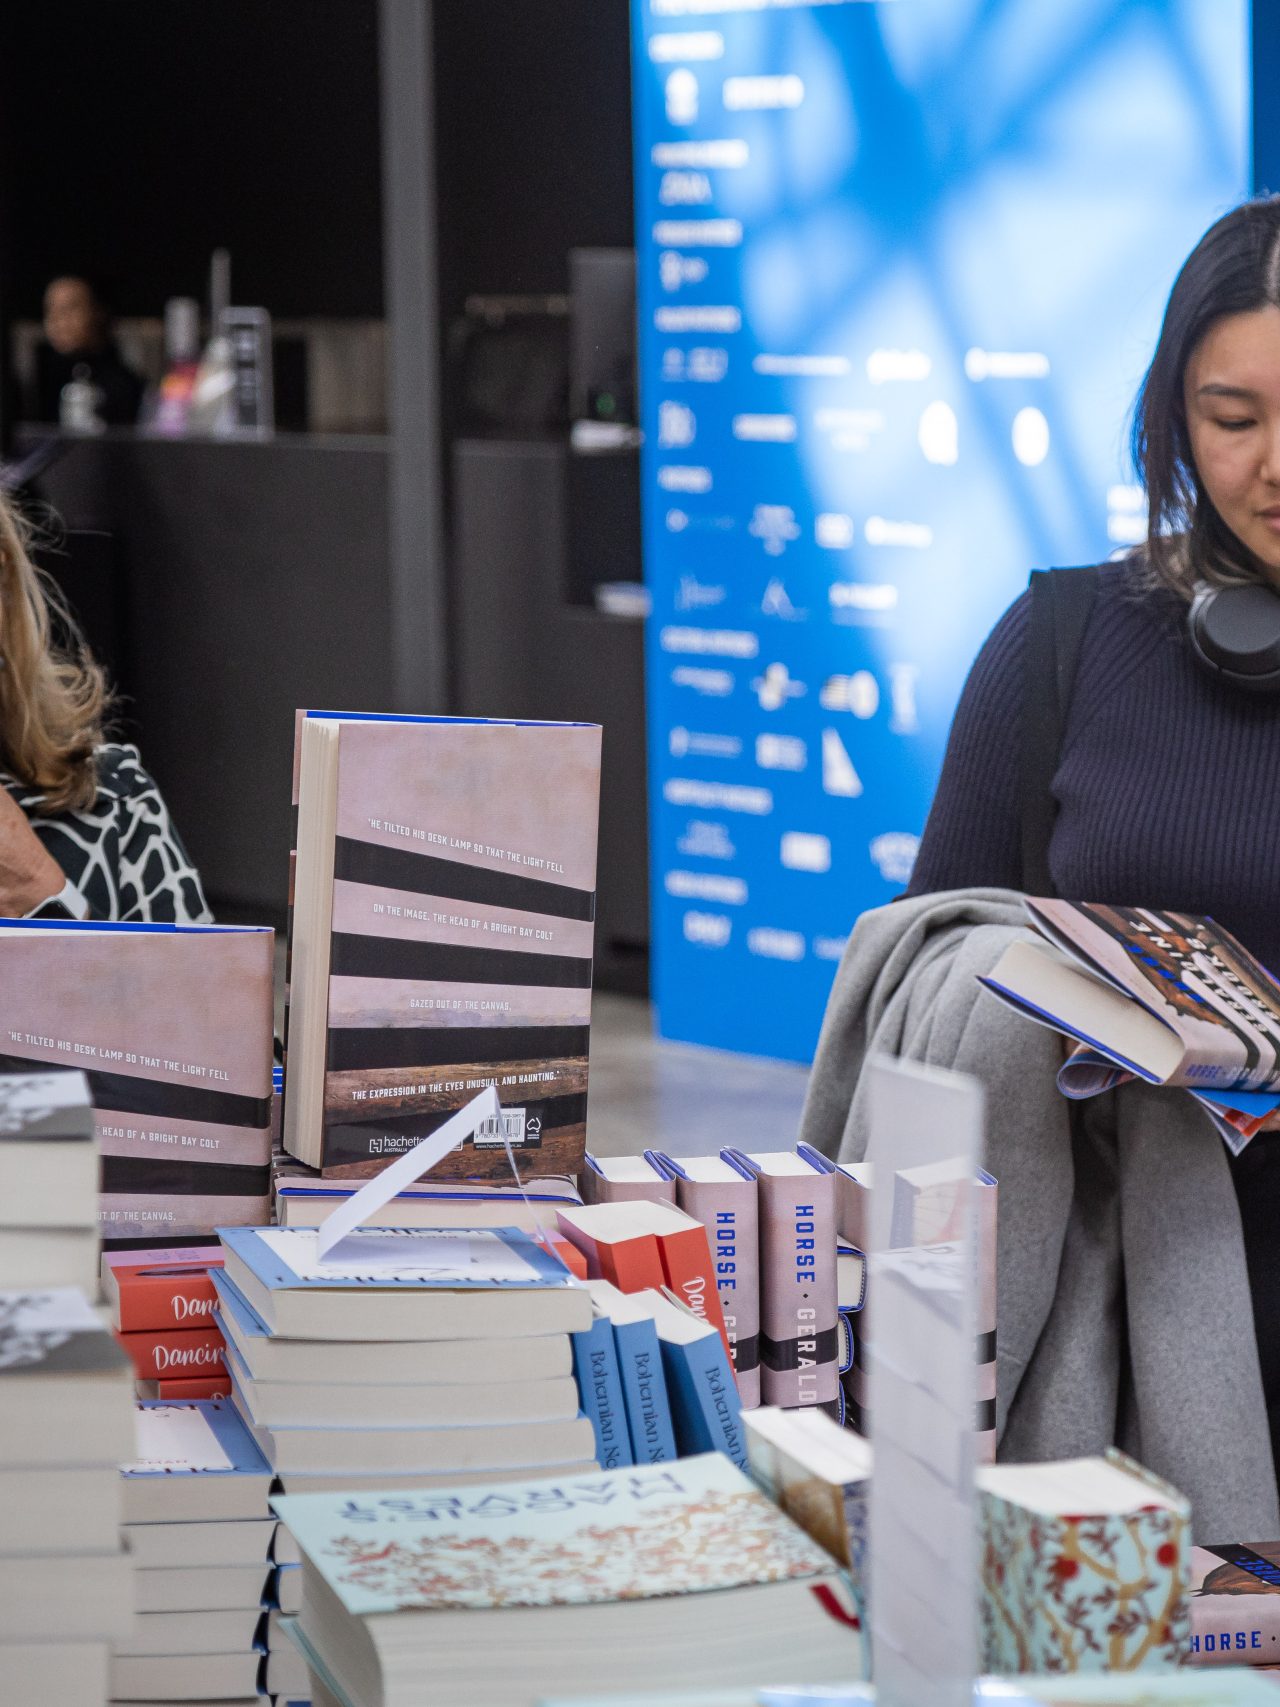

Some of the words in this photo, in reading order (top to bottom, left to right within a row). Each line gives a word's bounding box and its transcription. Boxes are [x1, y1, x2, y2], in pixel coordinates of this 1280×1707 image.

[384, 822, 410, 836] TILTED
[412, 829, 425, 840] HIS
[427, 832, 448, 846] DESK
[450, 838, 472, 850] LAMP
[473, 843, 483, 854] SO
[485, 846, 505, 860] THAT
[507, 851, 521, 863] THE
[523, 854, 545, 868] LIGHT
[546, 860, 565, 874] FELL
[373, 903, 384, 914] ON
[387, 905, 401, 917] THE
[433, 913, 447, 924] THE
[449, 915, 469, 927] HEAD
[471, 918, 481, 929] OF
[490, 921, 517, 935] BRIGHT
[519, 926, 533, 938] BAY
[535, 929, 554, 941] COLT
[410, 999, 434, 1009] GAZED
[436, 999, 451, 1009] OUT
[452, 999, 463, 1009] OF
[464, 999, 479, 1010] THE
[25, 1034, 54, 1048] TILTED
[57, 1040, 71, 1051] HIS
[74, 1044, 97, 1056] DESK
[100, 1048, 123, 1061] LAMP
[126, 1053, 136, 1064] SO
[139, 1055, 161, 1068] THAT
[164, 1060, 180, 1072] THE
[182, 1064, 206, 1077] LIGHT
[209, 1069, 229, 1081] FELL
[352, 1090, 367, 1100] THE
[369, 1086, 416, 1099] EXPRESSION
[418, 1084, 427, 1094] IN
[429, 1083, 443, 1093] THE
[445, 1080, 464, 1092] EYES
[466, 1078, 499, 1089] UNUSUAL
[501, 1075, 517, 1086] AND
[102, 1126, 124, 1139] HEAD
[127, 1128, 137, 1139] OF
[140, 1130, 146, 1141] A
[149, 1131, 178, 1144] BRIGHT
[181, 1135, 197, 1147] BAY
[200, 1138, 220, 1149] COLT
[110, 1212, 121, 1221] OF
[124, 1211, 139, 1221] THE
[716, 1212, 737, 1291] HORSE
[795, 1205, 816, 1283] HORSE
[1190, 1630, 1263, 1654] HORSE
